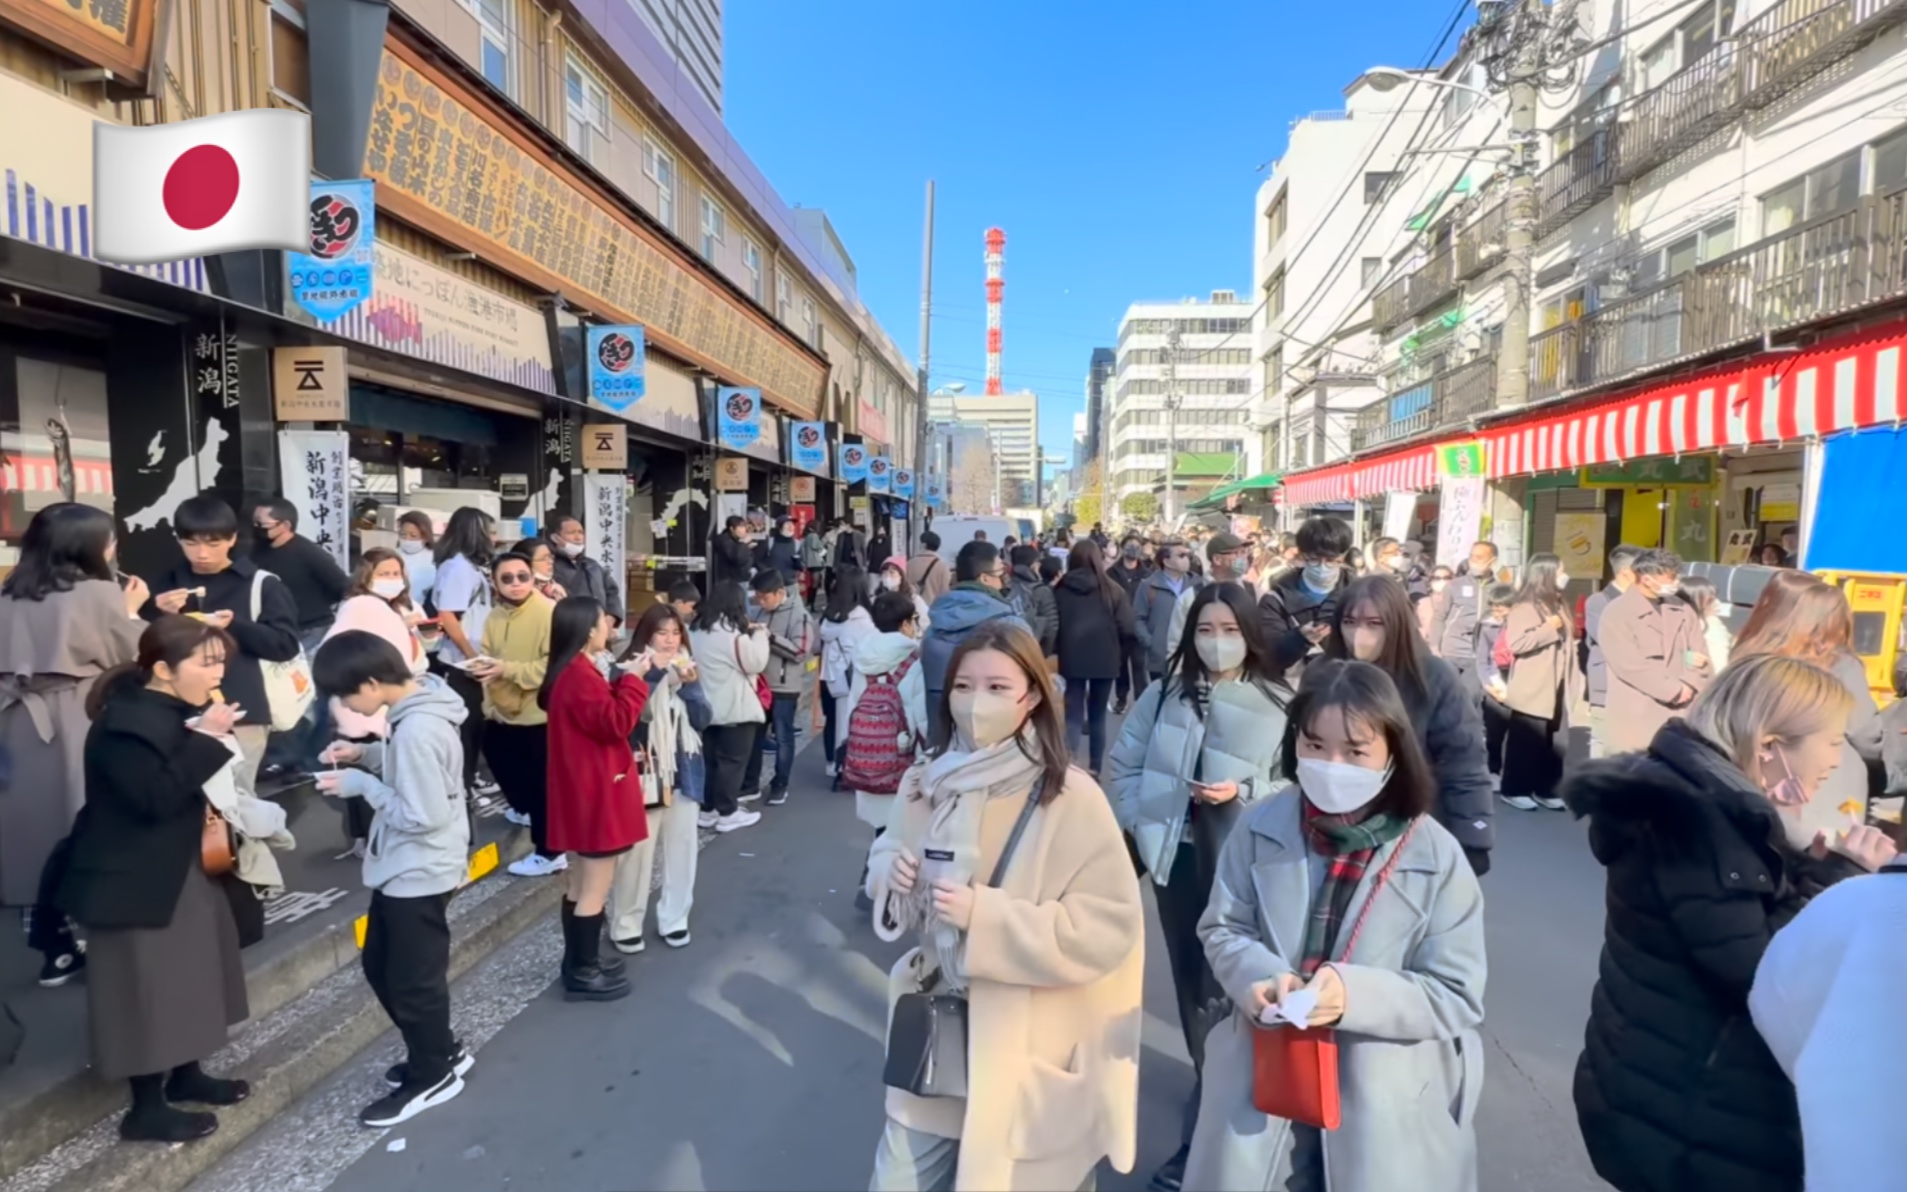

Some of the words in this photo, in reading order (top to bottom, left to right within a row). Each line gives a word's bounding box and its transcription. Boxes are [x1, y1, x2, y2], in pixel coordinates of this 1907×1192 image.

[195, 333, 222, 395] 新潟
[226, 333, 240, 407] NIIGATA
[563, 419, 572, 462] NIIGATA
[306, 450, 334, 553] 新潟中央
